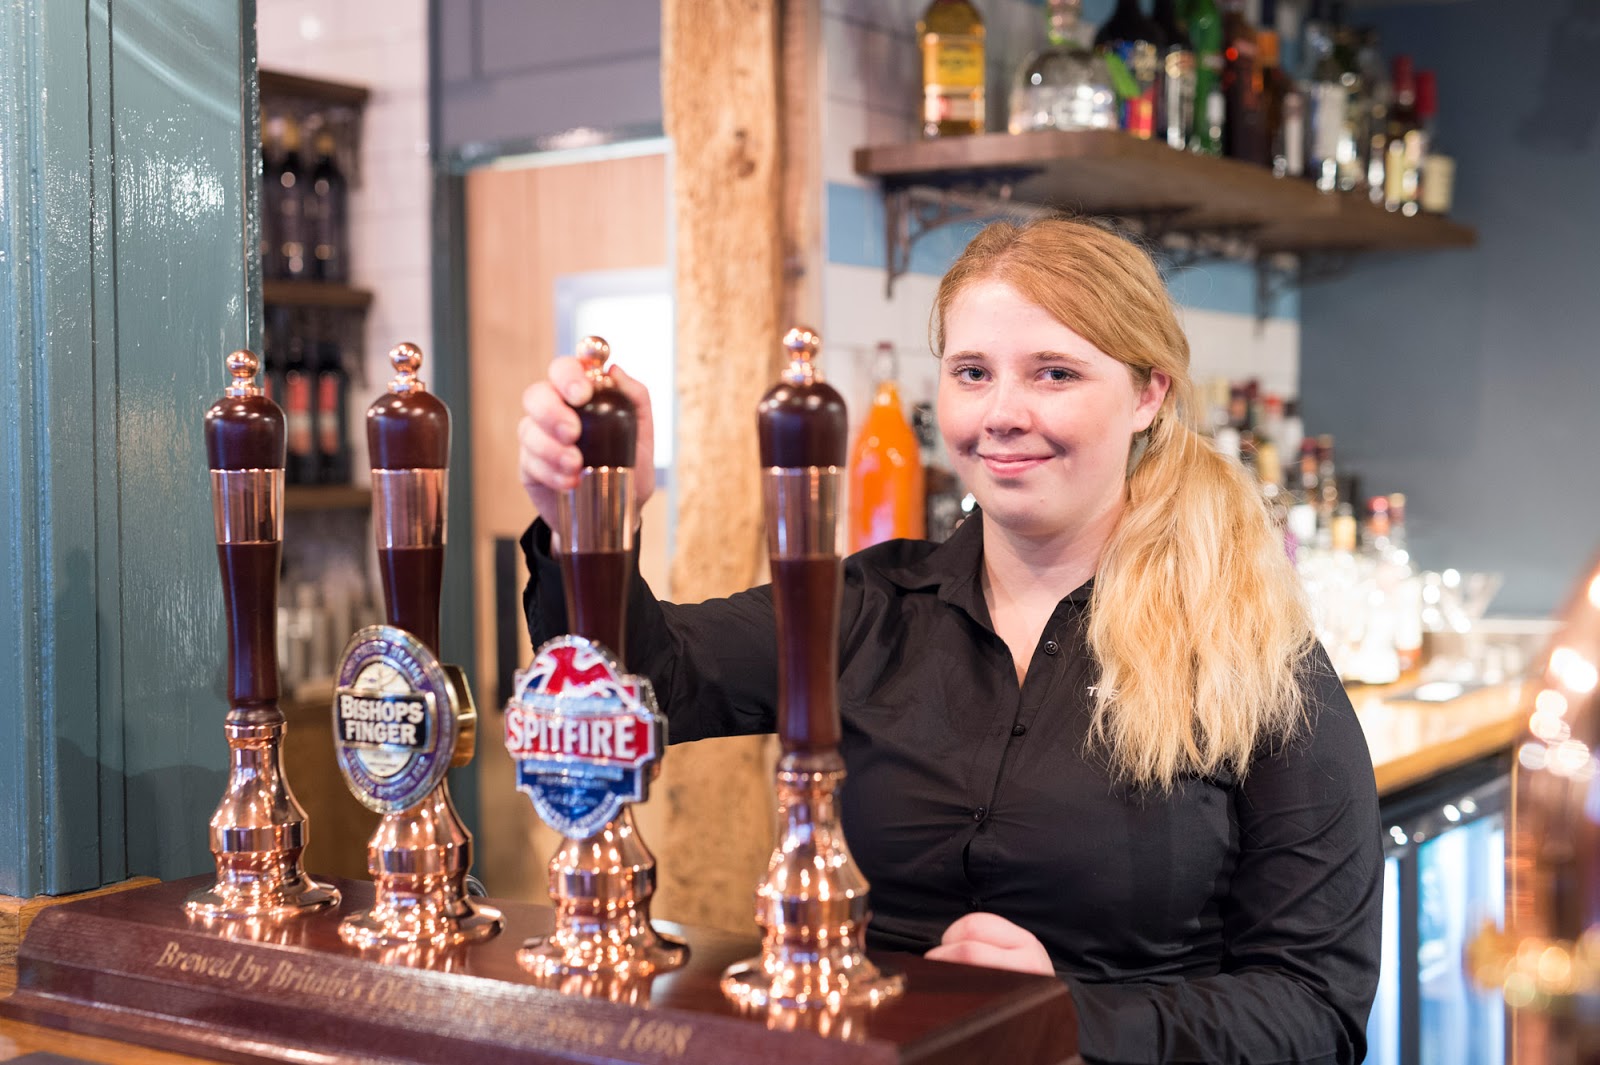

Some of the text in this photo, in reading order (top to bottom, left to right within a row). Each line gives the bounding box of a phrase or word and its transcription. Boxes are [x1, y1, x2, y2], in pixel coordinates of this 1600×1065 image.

[340, 695, 424, 724] BISHOPS
[345, 720, 417, 745] FINGER
[507, 708, 637, 758] SPITFIRE
[156, 941, 242, 979] Brewed
[239, 955, 270, 989] by
[269, 959, 363, 998] Britain's
[618, 1017, 693, 1057] 1698
